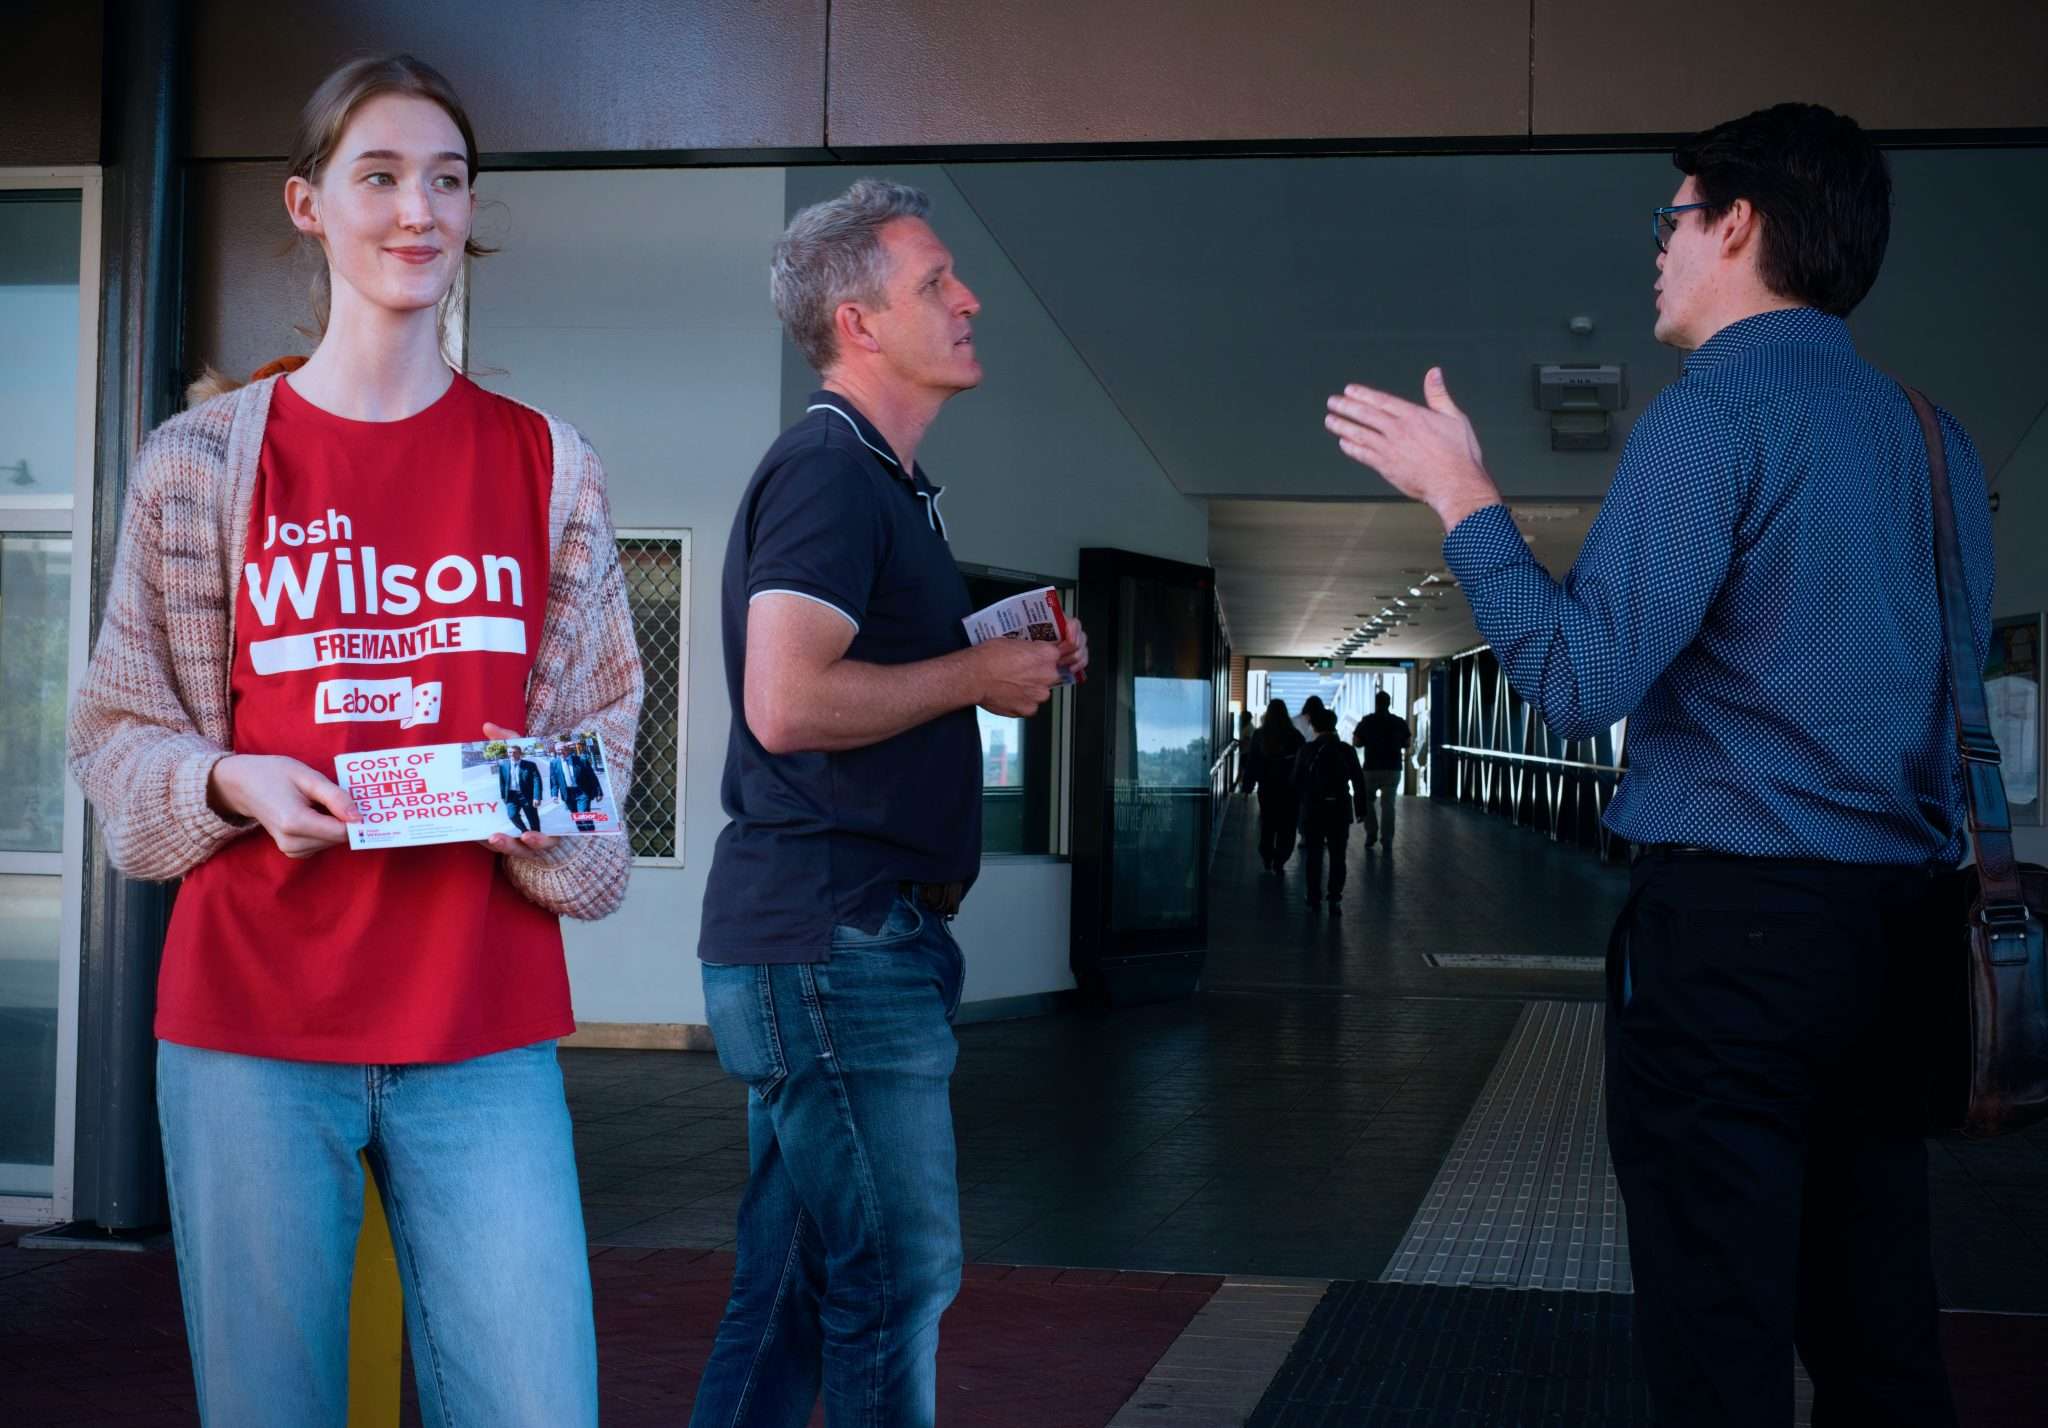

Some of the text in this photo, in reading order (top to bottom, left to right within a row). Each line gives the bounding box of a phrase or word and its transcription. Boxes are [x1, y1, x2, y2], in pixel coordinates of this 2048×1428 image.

[264, 508, 352, 550] Josh
[245, 546, 523, 626] Wilson
[313, 622, 462, 662] FREMANTLE
[323, 687, 401, 714] Labor
[347, 752, 435, 772] COST OF
[349, 768, 418, 786] LIVING
[352, 780, 424, 800] RELIEF
[379, 791, 469, 810] LABOR'S
[404, 802, 499, 820] PRIORITY
